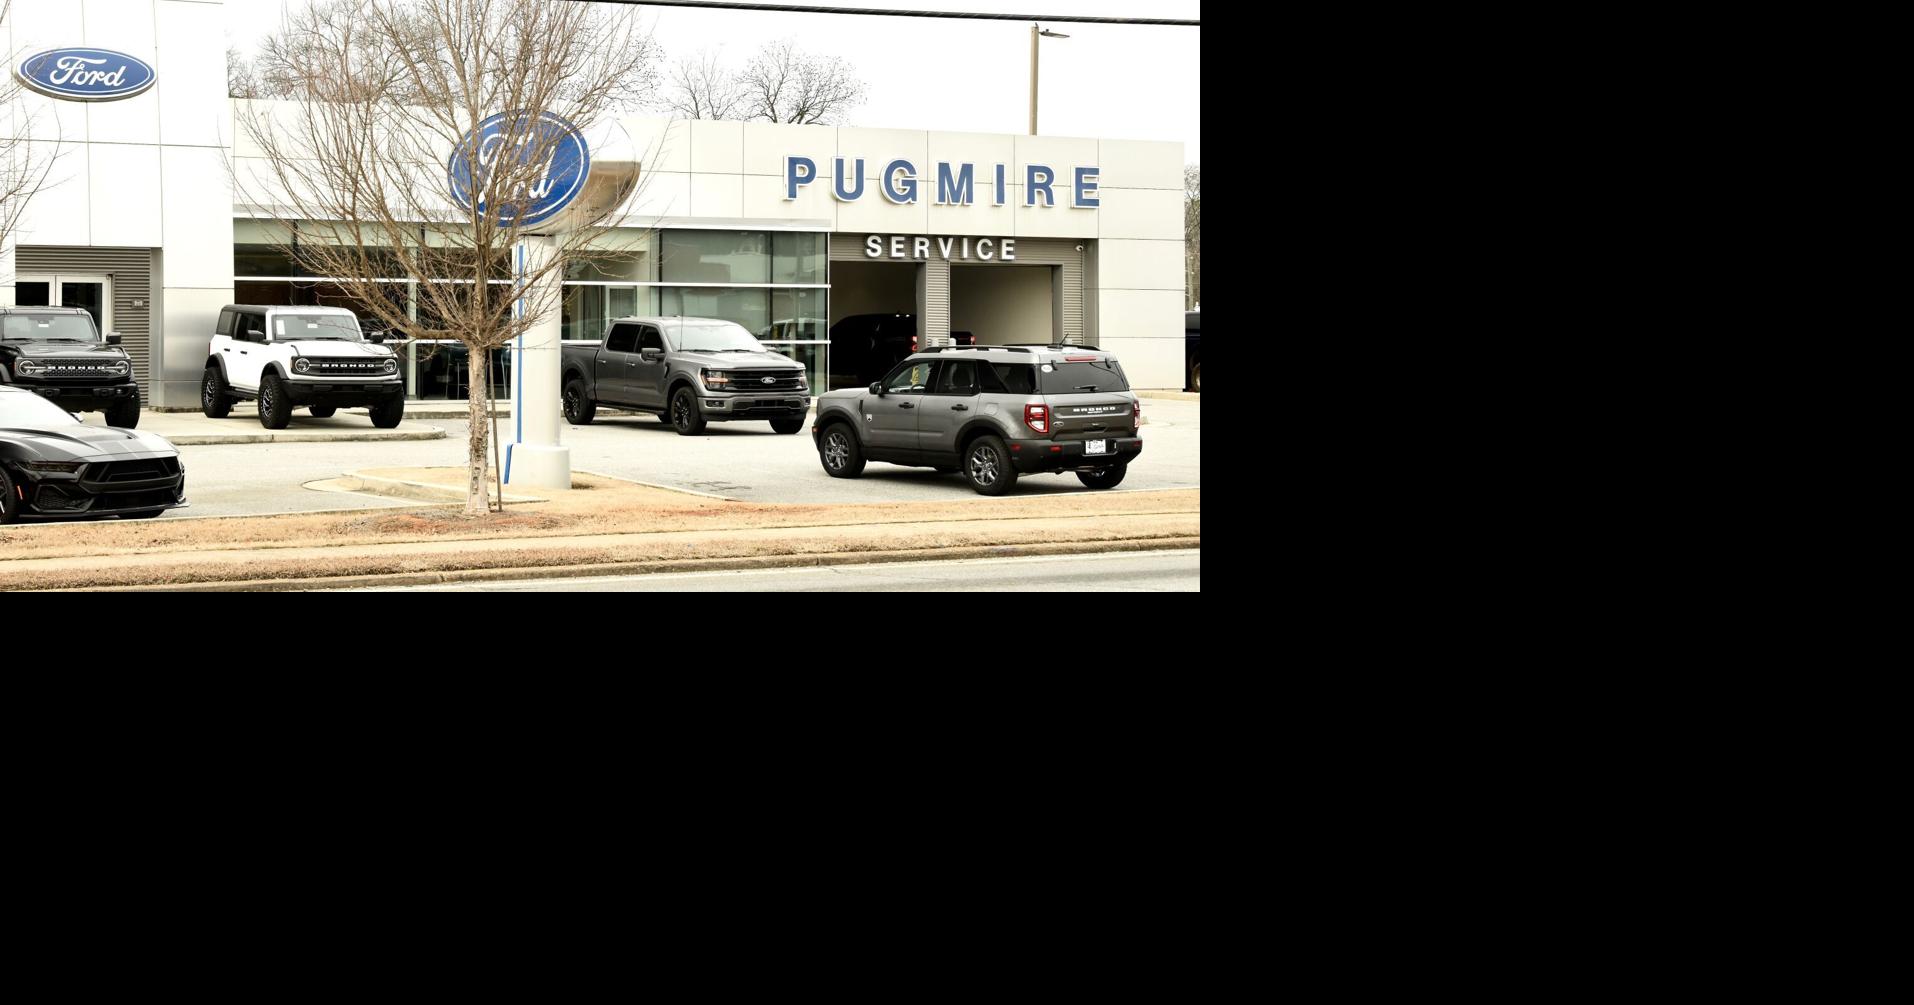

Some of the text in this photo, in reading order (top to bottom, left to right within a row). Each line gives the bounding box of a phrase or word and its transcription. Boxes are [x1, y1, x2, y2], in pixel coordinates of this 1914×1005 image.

[49, 55, 127, 87] Ford
[784, 155, 1101, 208] PUGMIRE
[865, 233, 1016, 261] SERVICE
